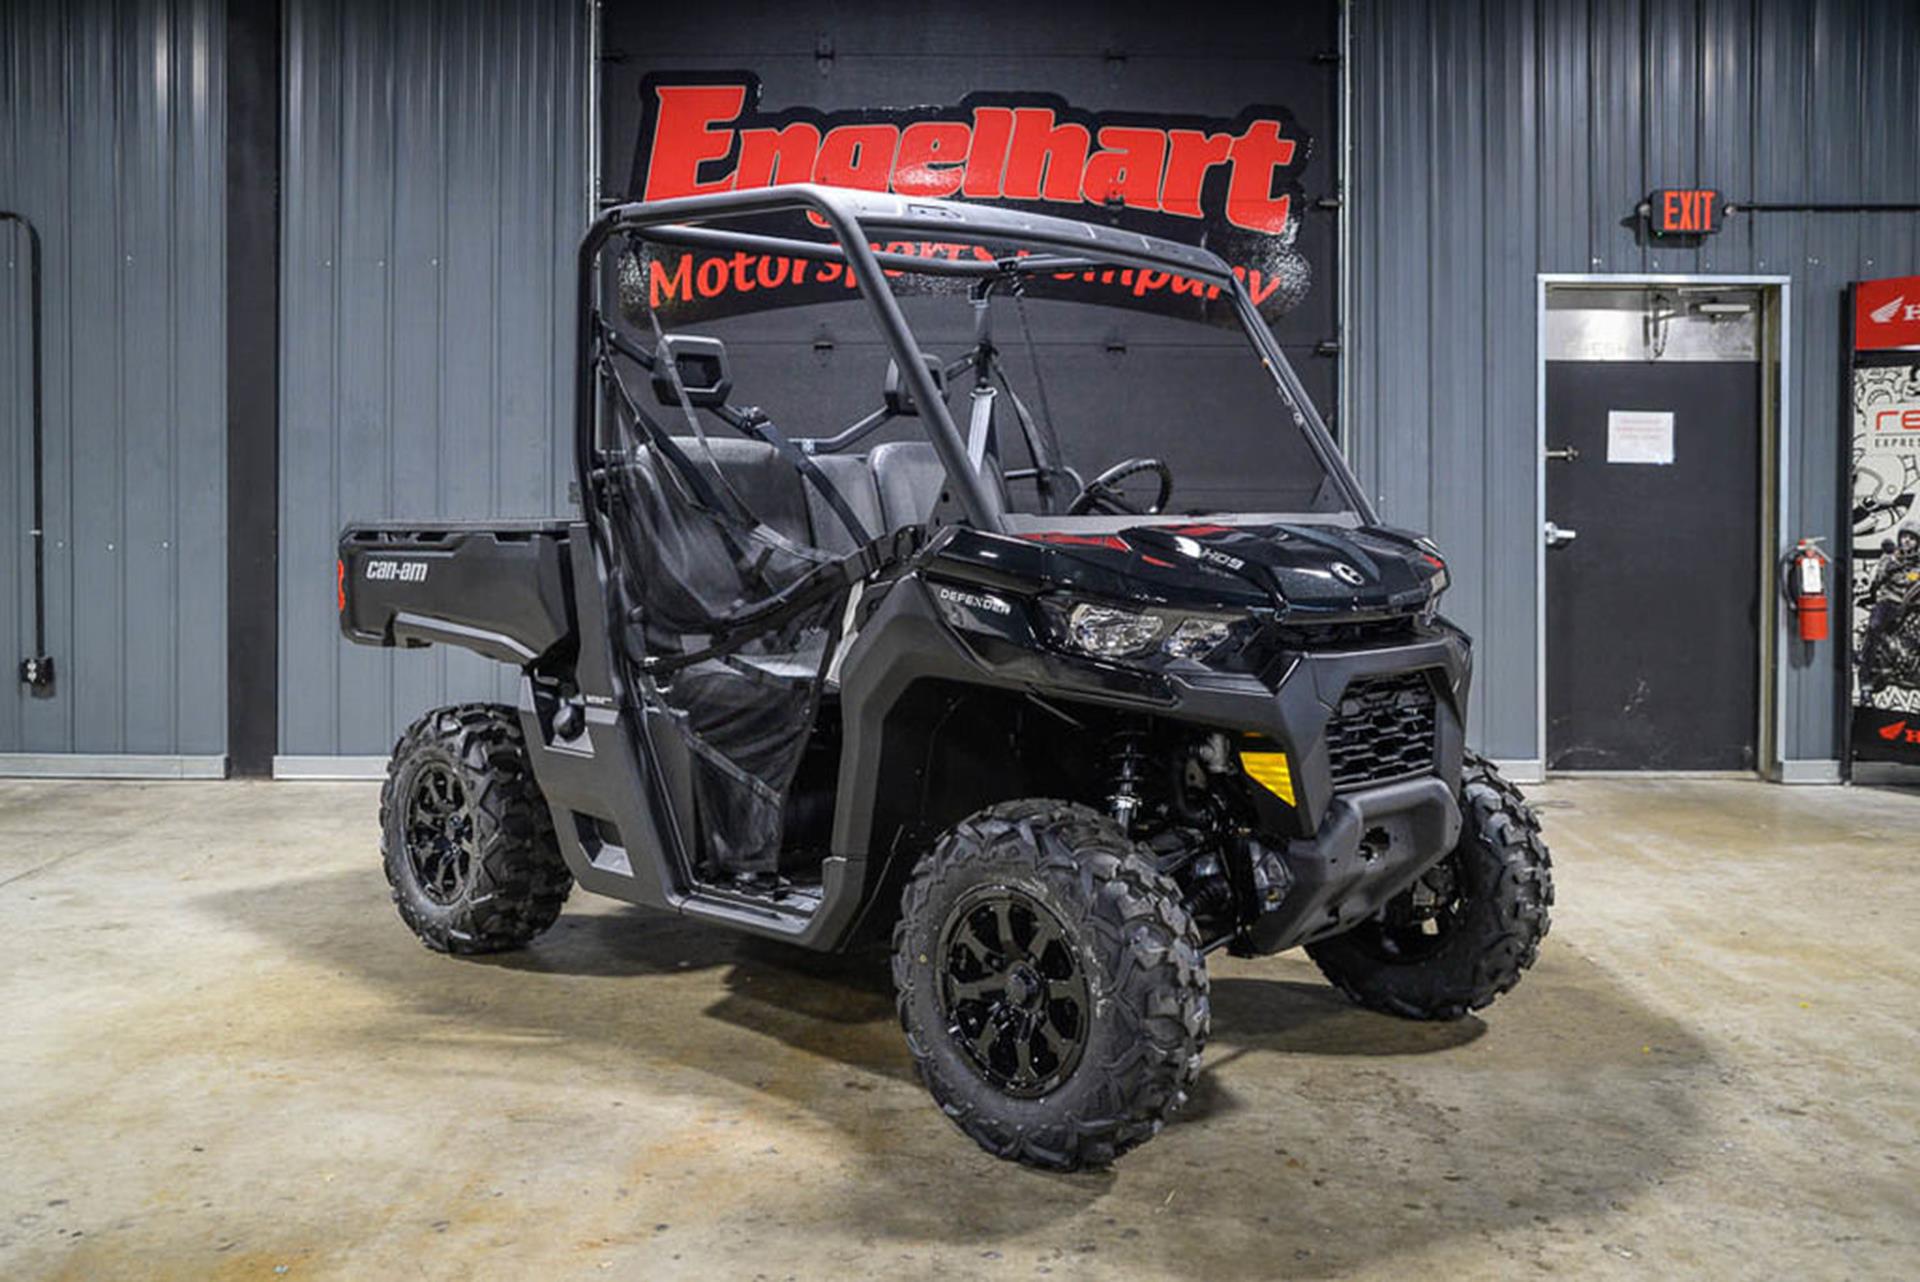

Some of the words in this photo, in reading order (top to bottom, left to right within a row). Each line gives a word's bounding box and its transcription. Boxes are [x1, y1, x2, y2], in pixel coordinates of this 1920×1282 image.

[644, 85, 1296, 235] Engelhart
[1663, 190, 1716, 231] EXIT
[366, 561, 429, 582] can-am
[940, 588, 1011, 615] DEFENDER
